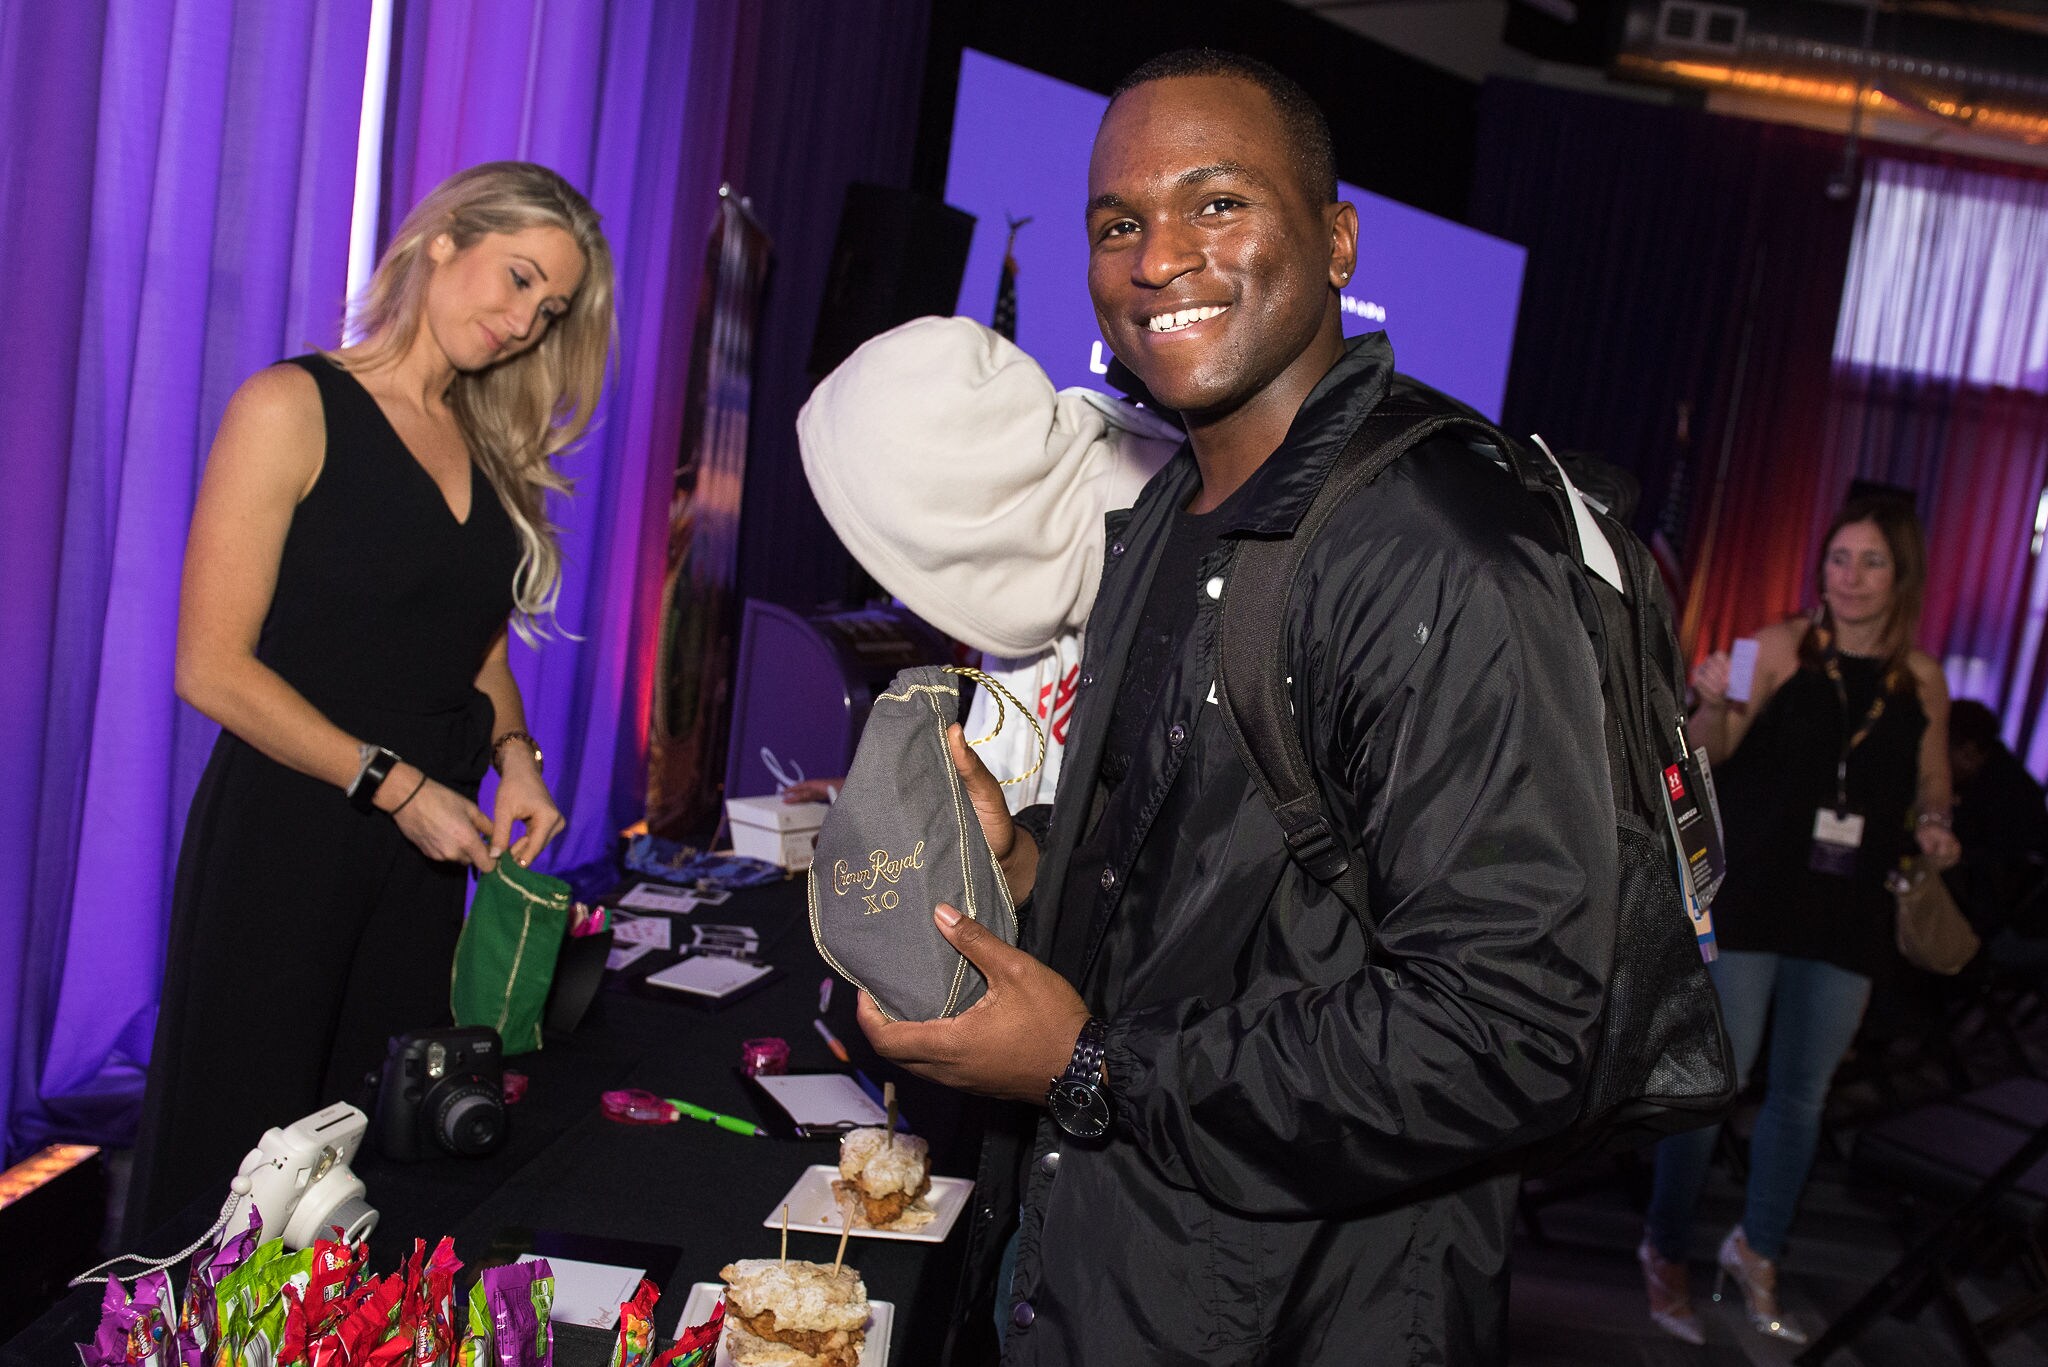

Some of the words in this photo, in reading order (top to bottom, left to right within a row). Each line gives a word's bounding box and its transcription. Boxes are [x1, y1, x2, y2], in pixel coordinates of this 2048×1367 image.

[832, 859, 870, 895] Crown
[862, 840, 925, 890] Royal
[862, 890, 899, 915] XO
